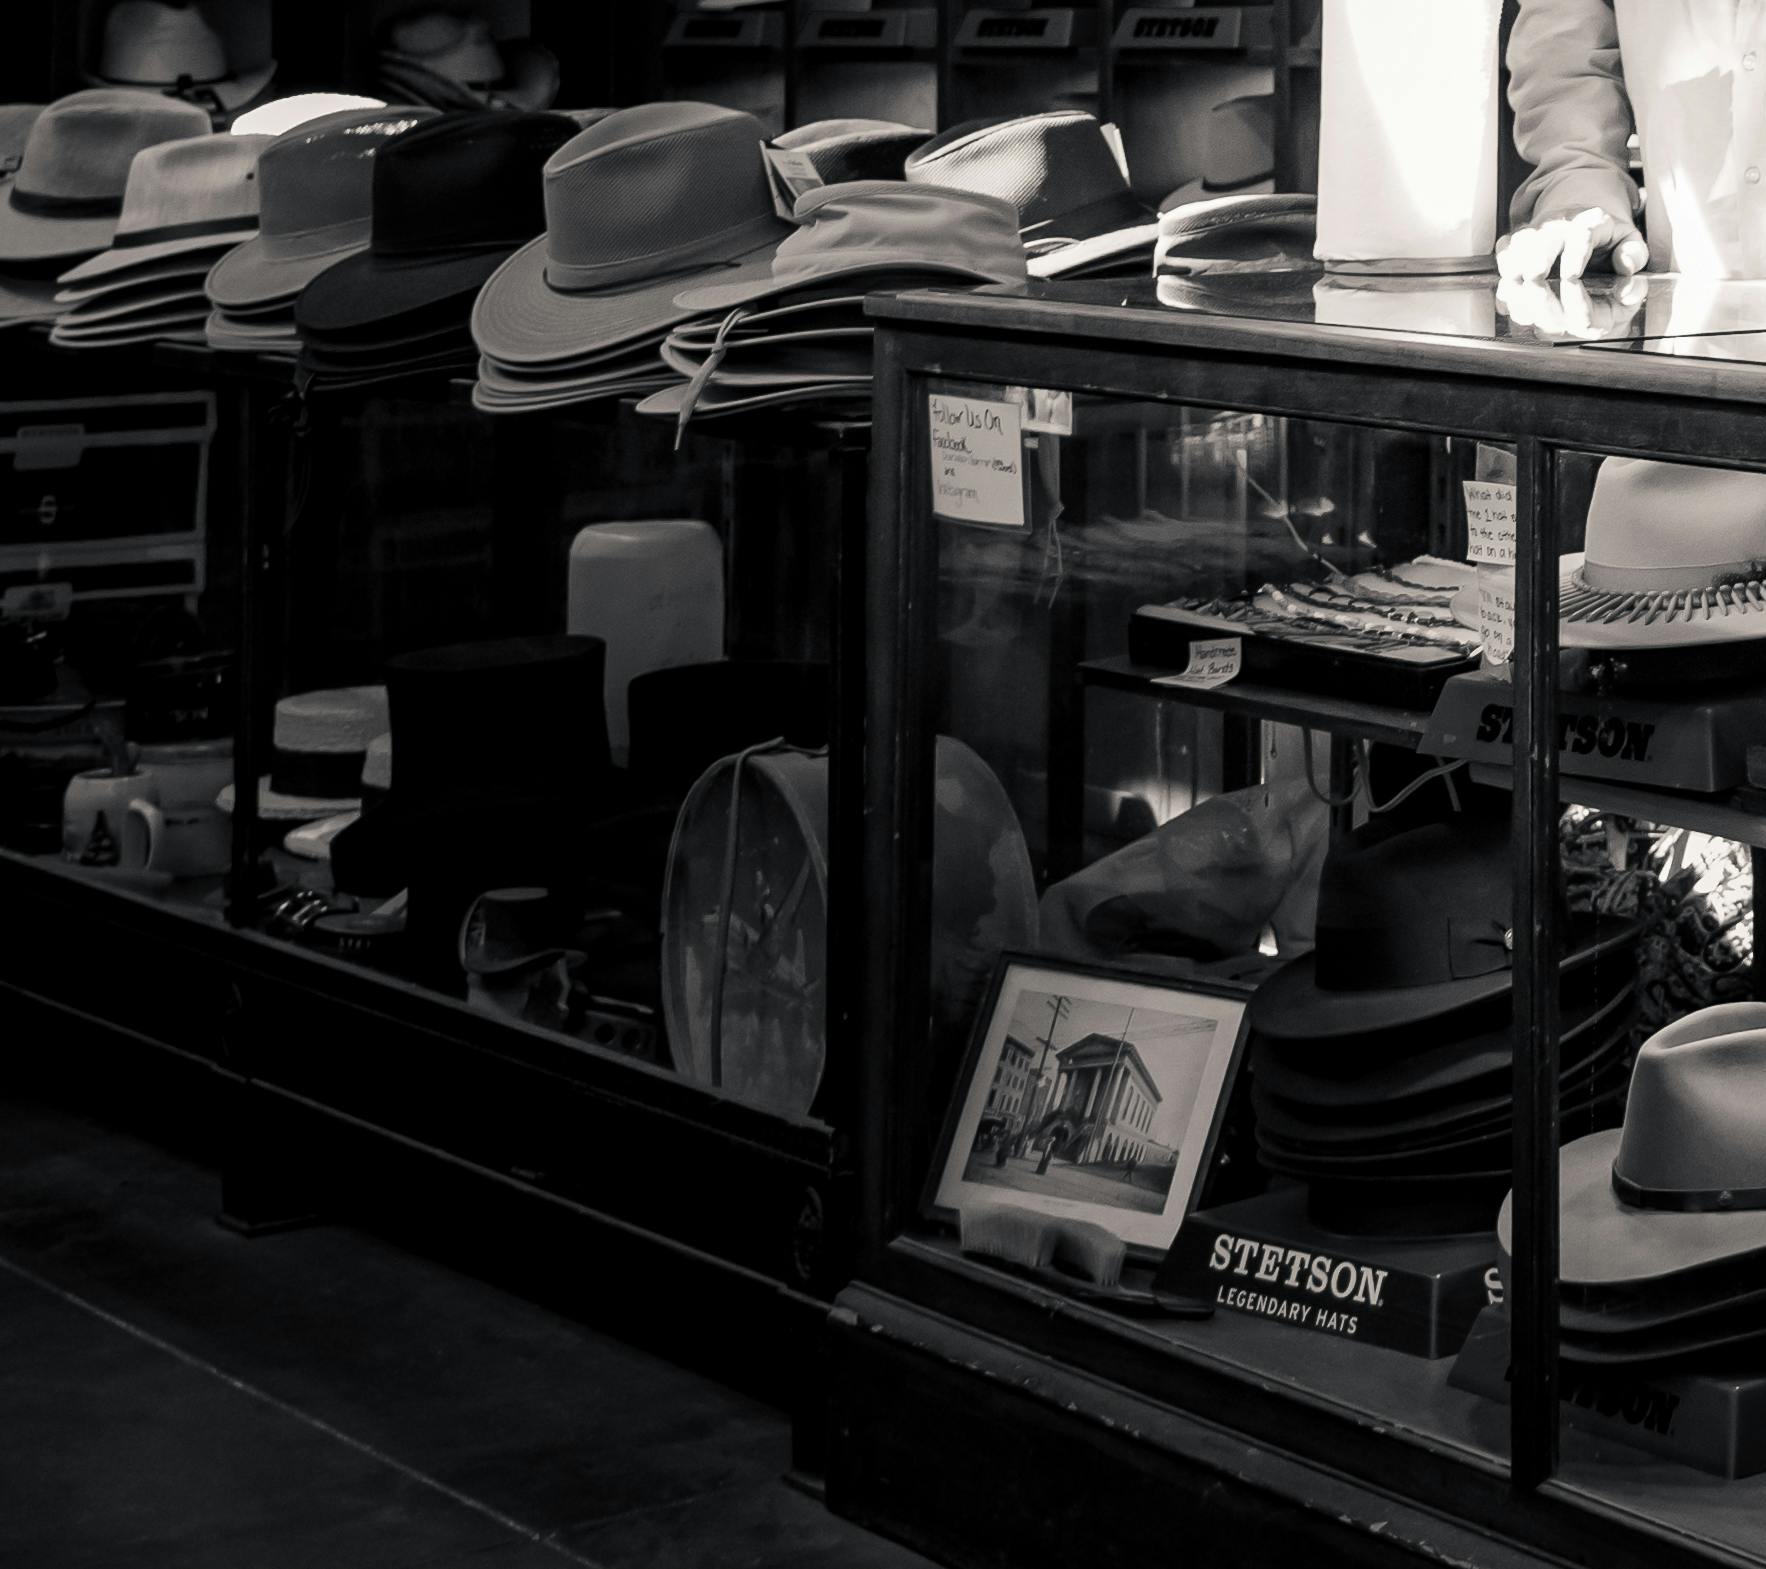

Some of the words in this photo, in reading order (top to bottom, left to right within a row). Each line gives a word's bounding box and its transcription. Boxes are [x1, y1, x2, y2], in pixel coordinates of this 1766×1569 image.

[965, 404, 982, 429] Us
[1208, 1233, 1389, 1308] STETSON
[1215, 1284, 1313, 1323] LEGENDARY
[1314, 1307, 1359, 1335] HATS
